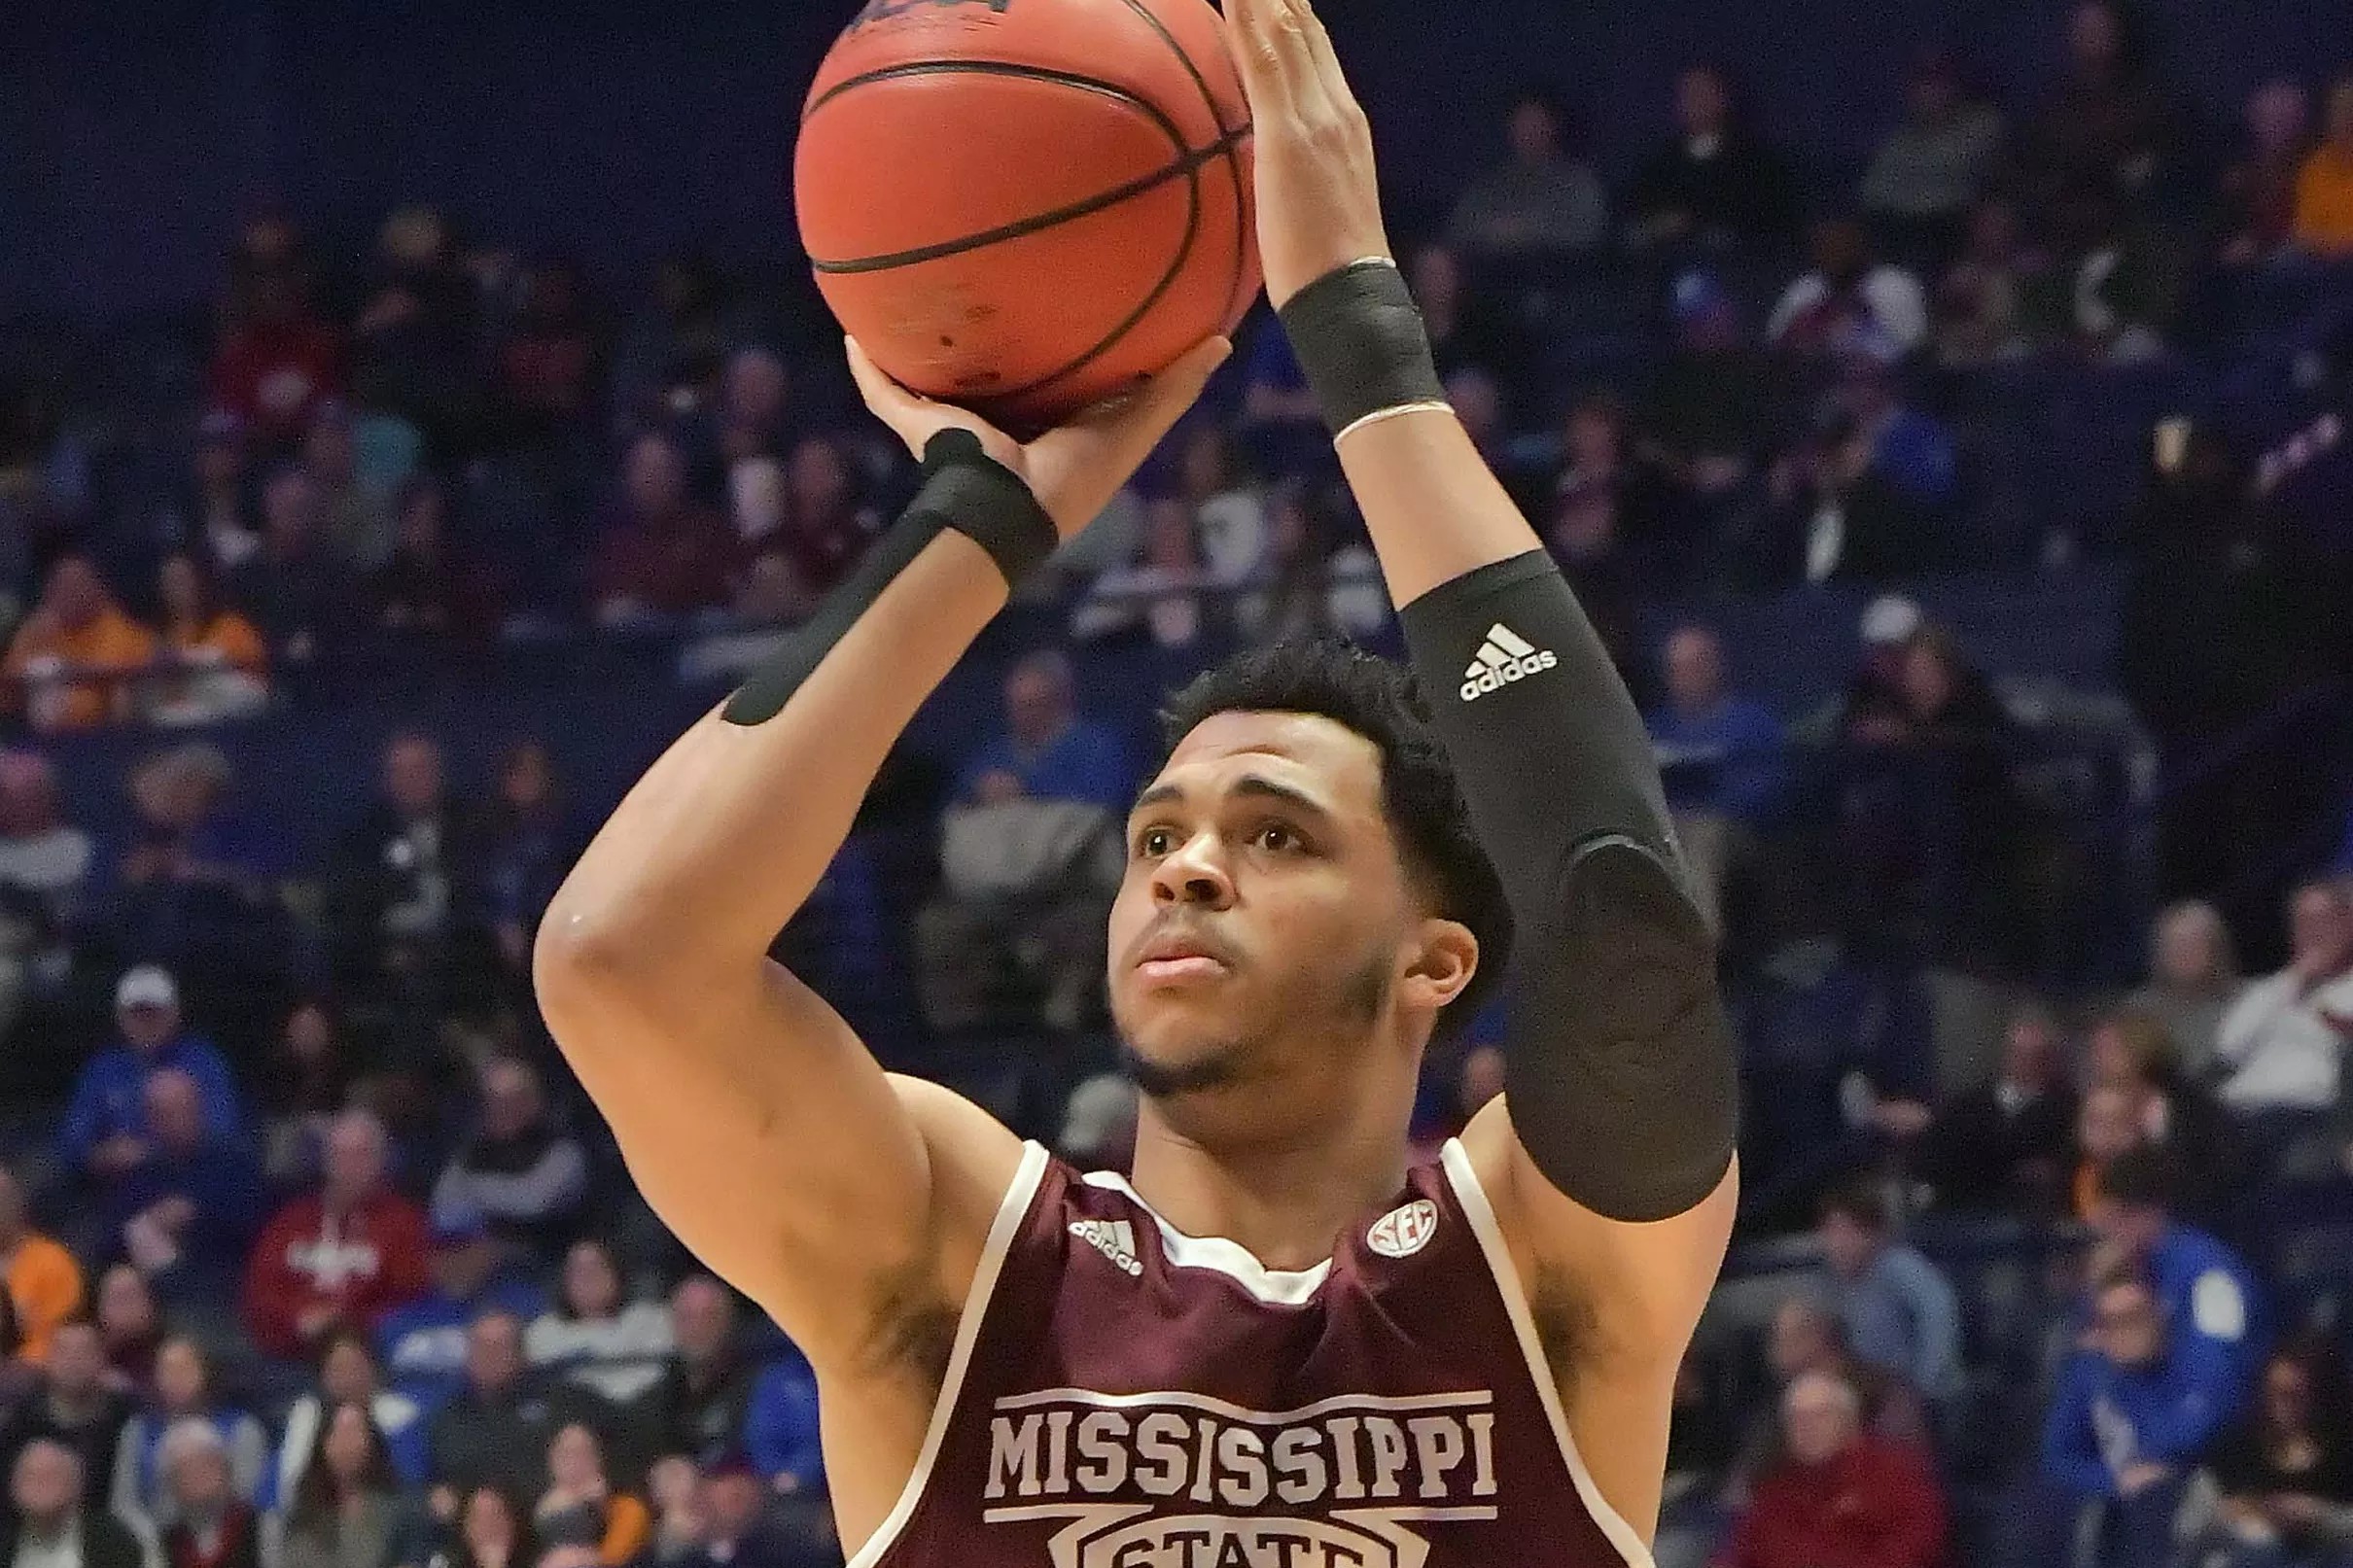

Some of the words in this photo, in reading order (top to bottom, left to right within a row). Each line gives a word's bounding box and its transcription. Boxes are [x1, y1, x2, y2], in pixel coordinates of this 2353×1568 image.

[1459, 650, 1558, 701] adidas
[1369, 1202, 1435, 1255] SEC
[984, 1411, 1497, 1507] MISSISSIPPI
